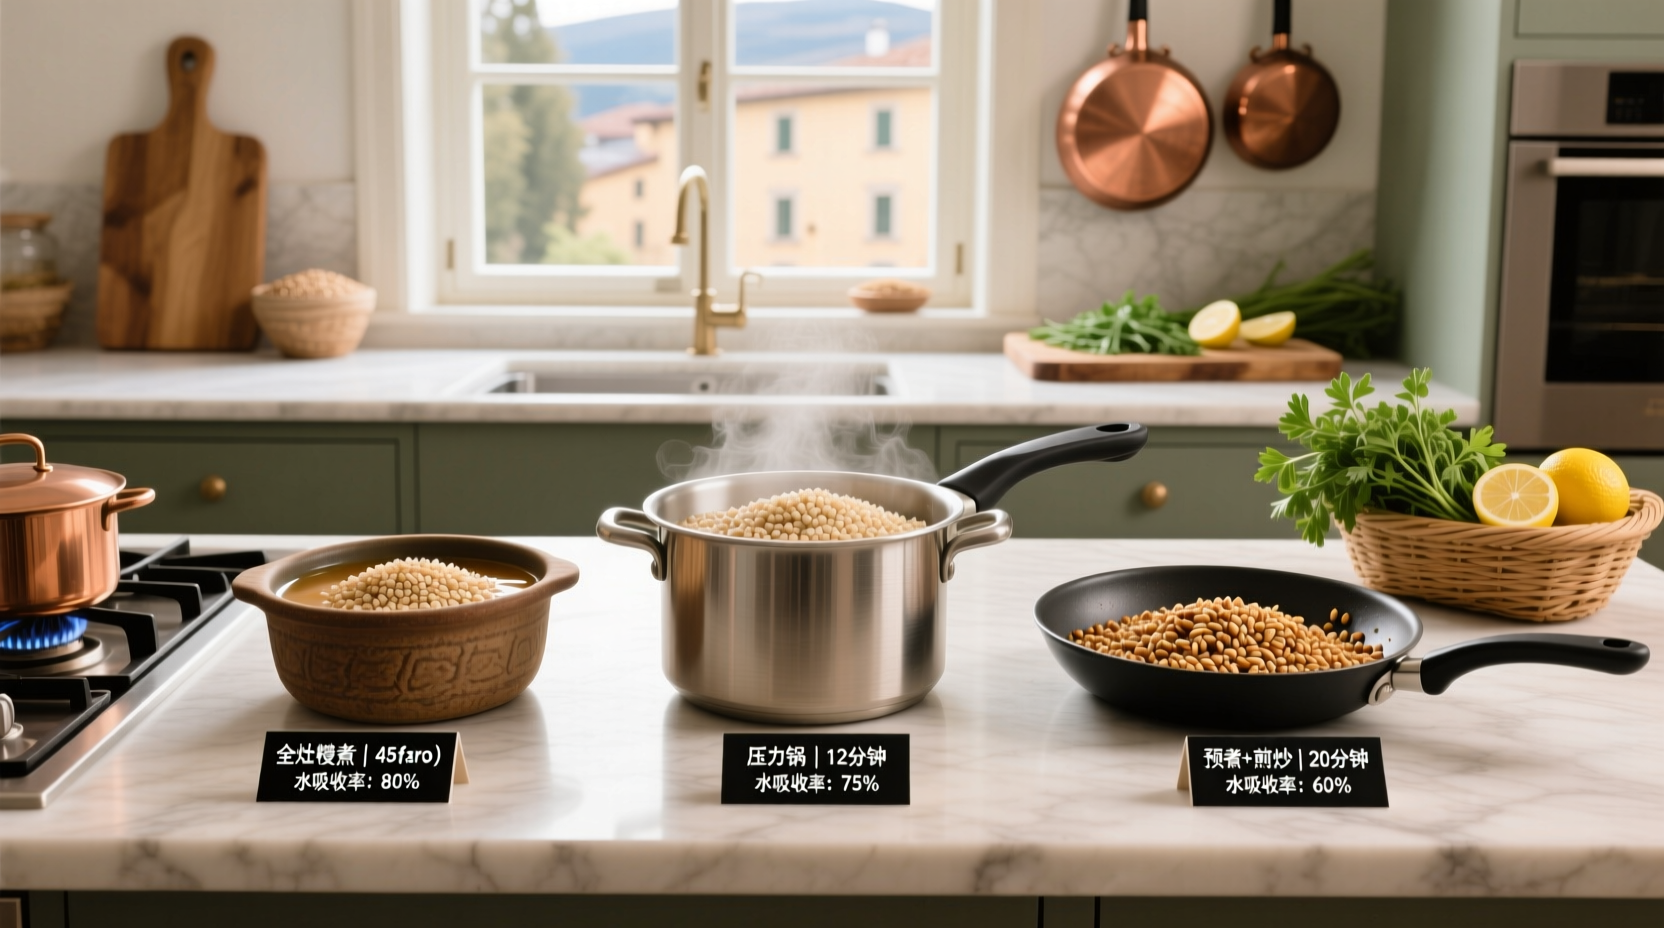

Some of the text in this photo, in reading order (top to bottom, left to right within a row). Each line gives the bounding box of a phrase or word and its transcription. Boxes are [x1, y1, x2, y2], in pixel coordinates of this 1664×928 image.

[747, 746, 807, 767] 压力锅
[828, 746, 887, 768] 12分钟
[1309, 748, 1369, 769] 20分钟
